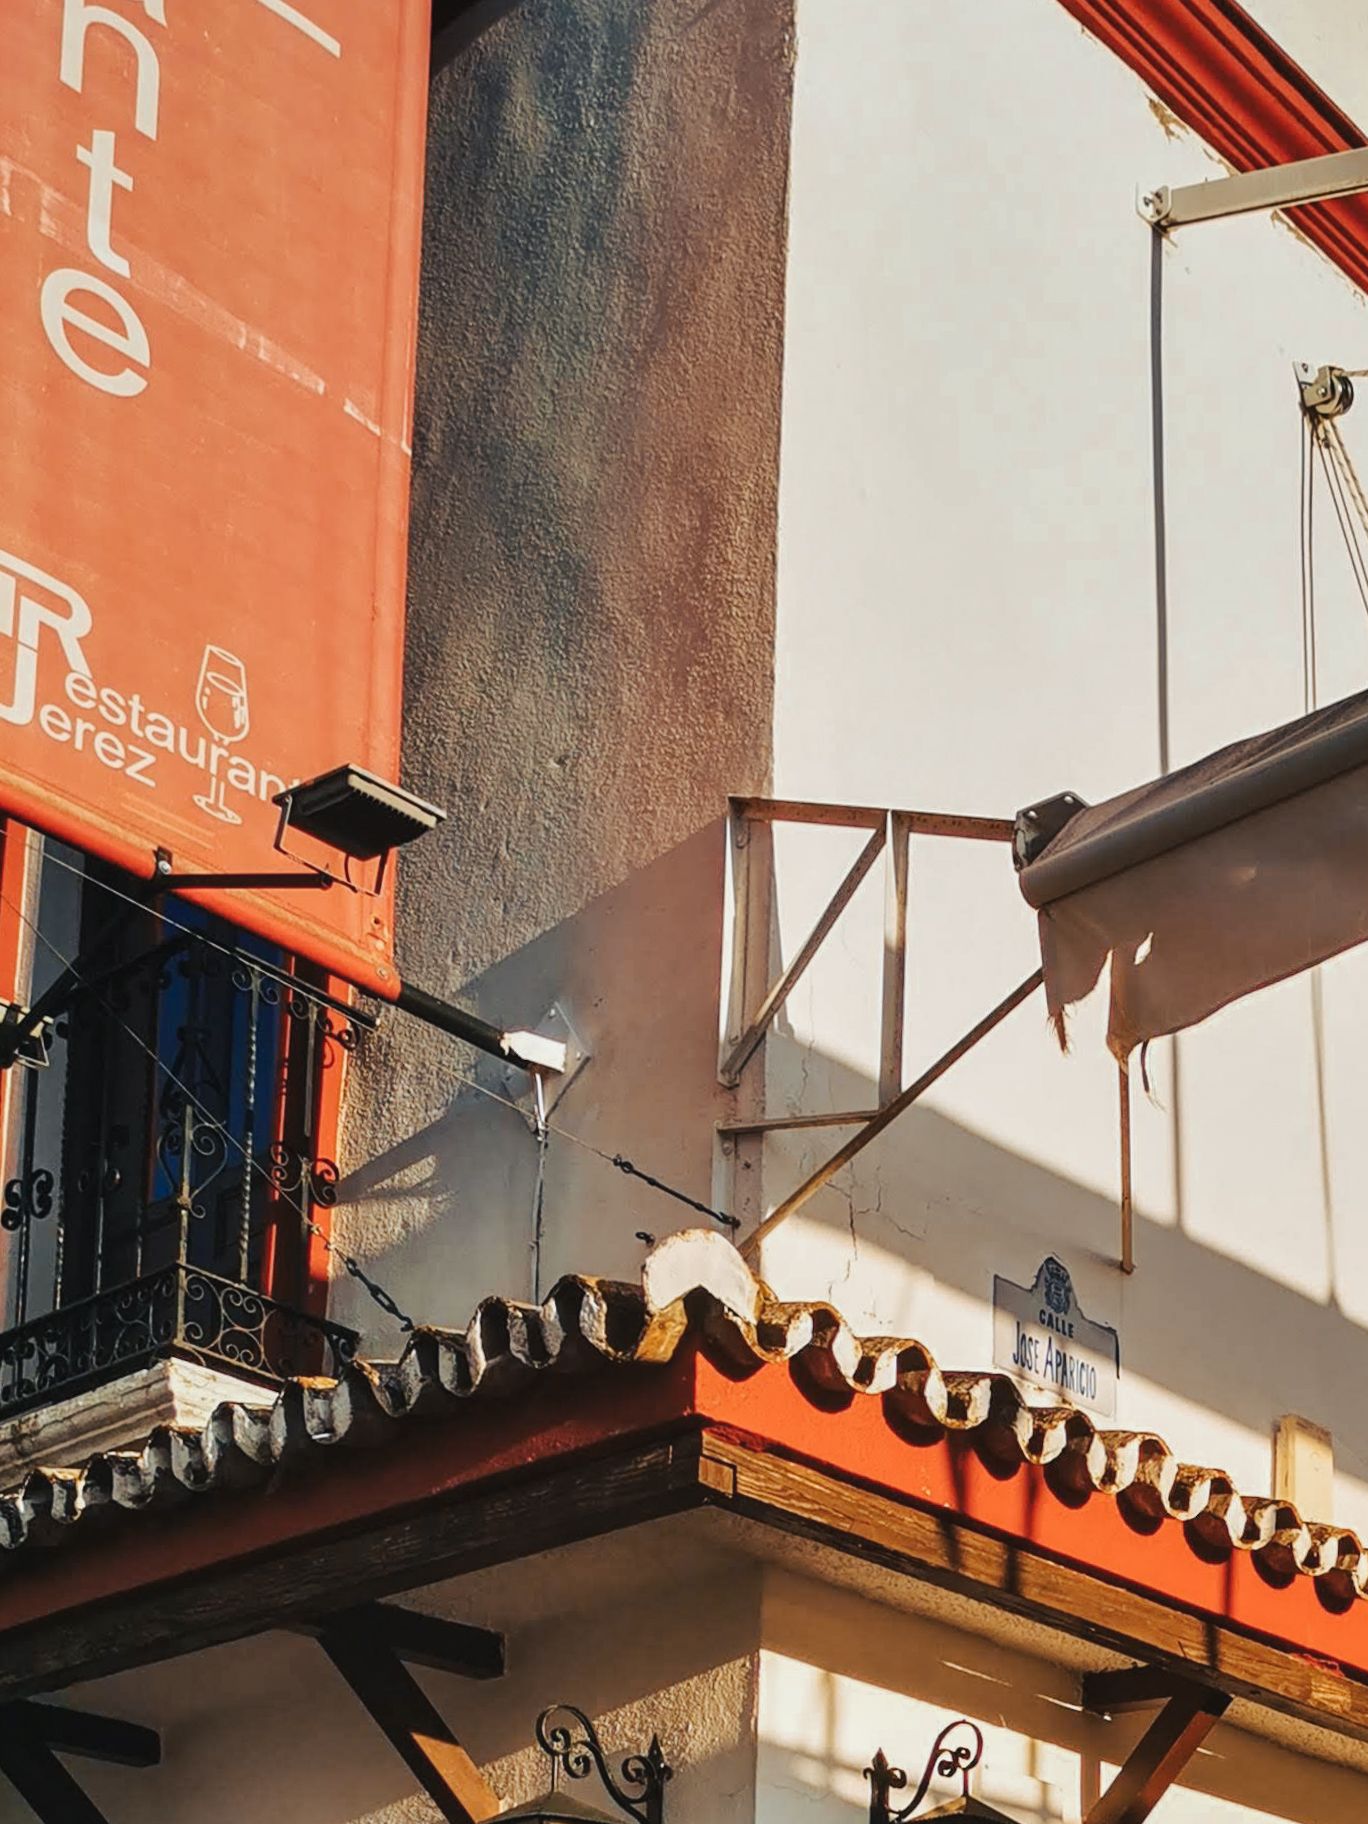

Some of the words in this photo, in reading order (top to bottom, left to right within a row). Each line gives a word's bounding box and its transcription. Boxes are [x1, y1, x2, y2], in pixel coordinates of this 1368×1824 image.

[40, 0, 167, 397] nte
[0, 547, 304, 801] Restauran
[1039, 1308, 1074, 1339] CALLE
[1043, 1335, 1097, 1400] APARICIO
